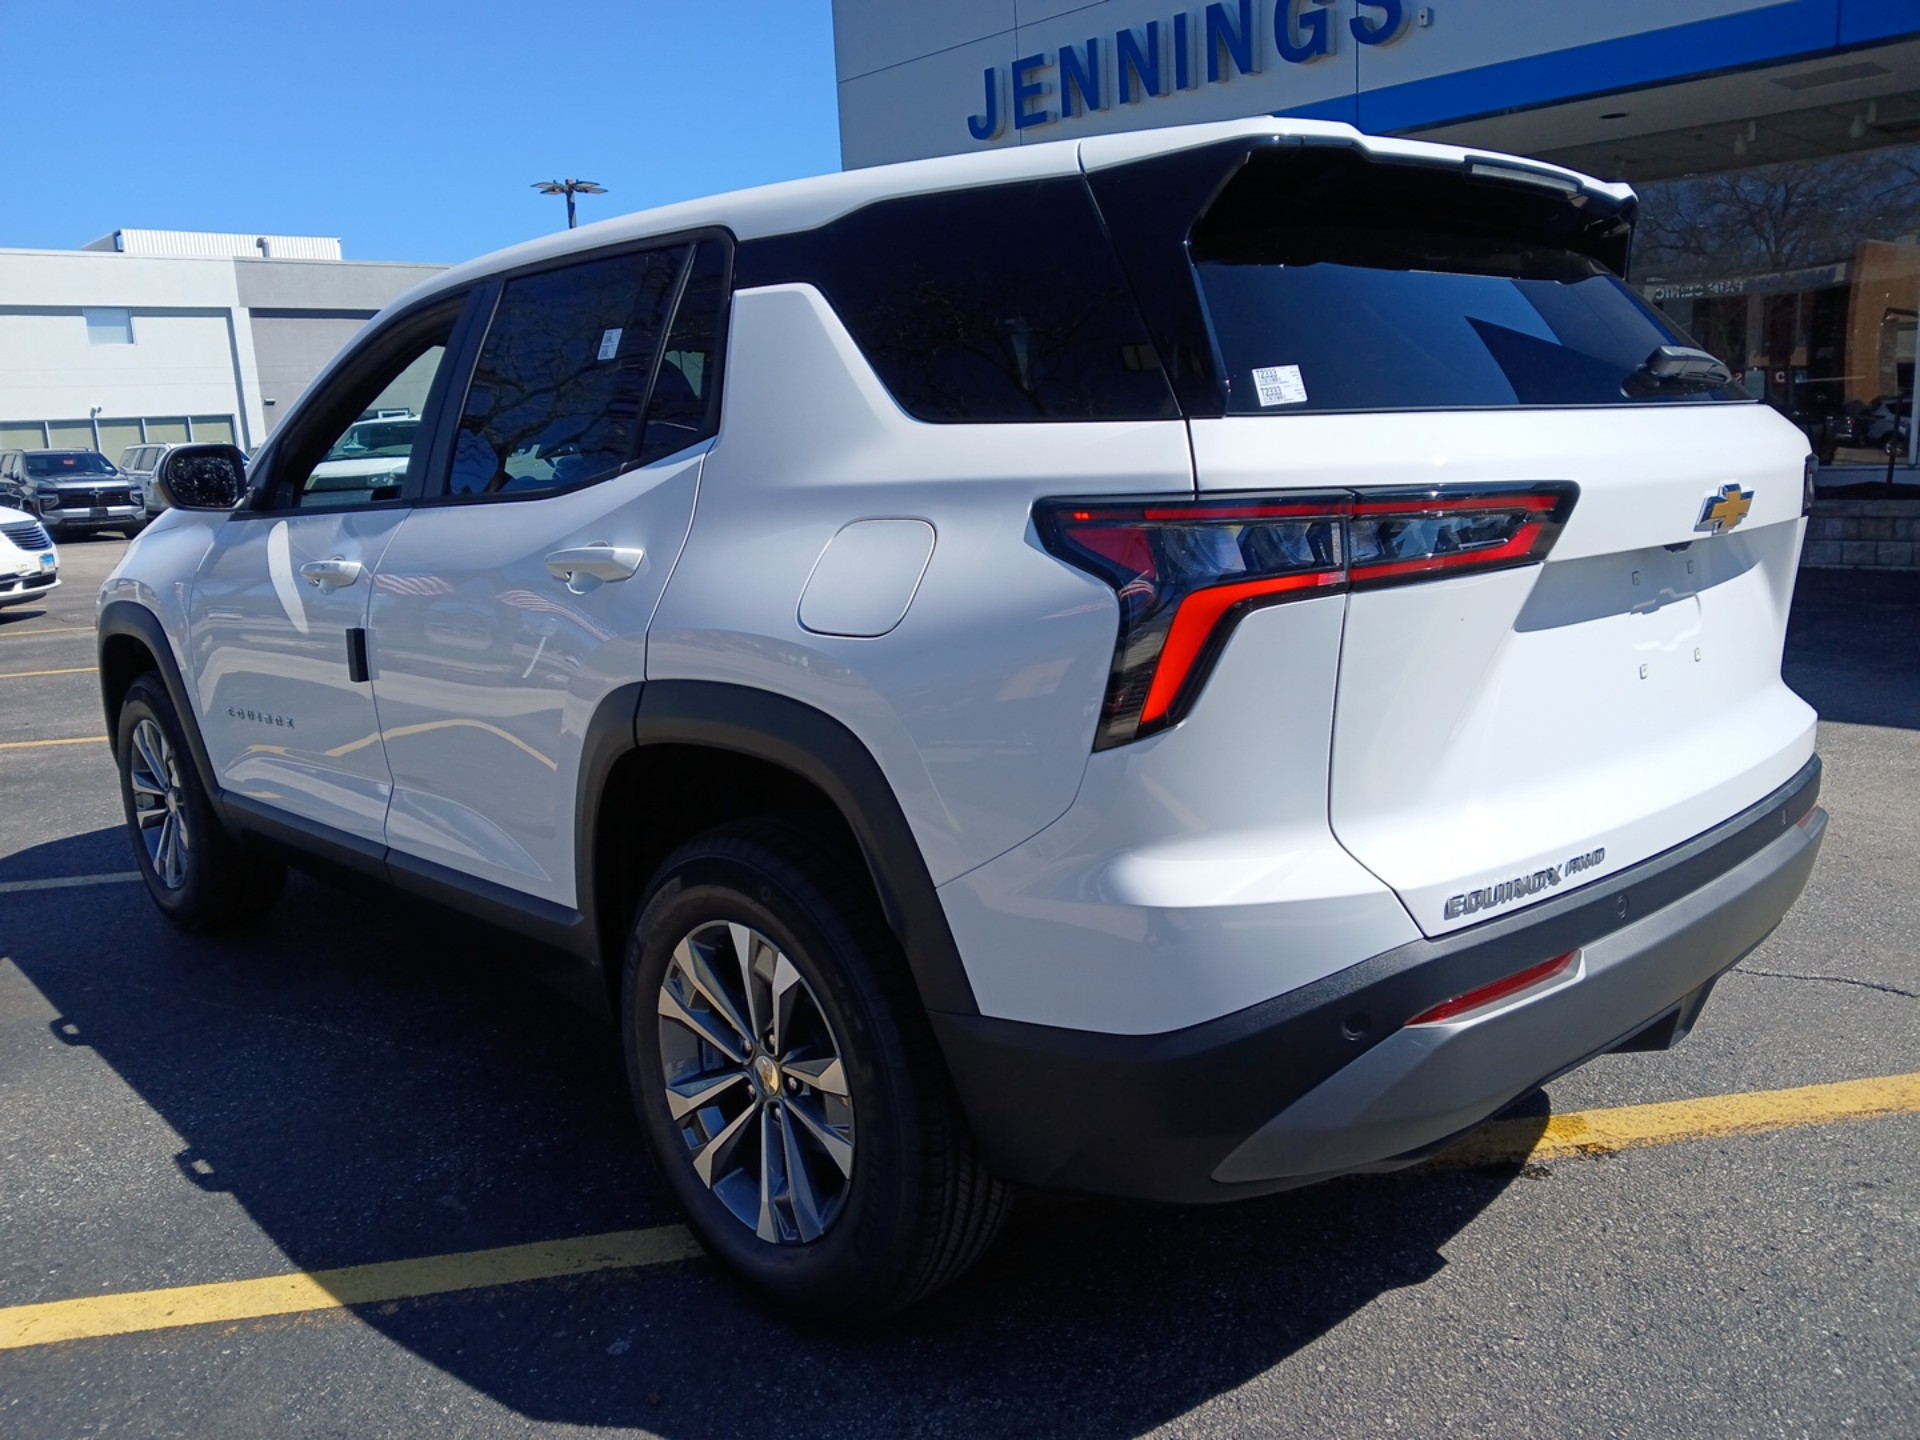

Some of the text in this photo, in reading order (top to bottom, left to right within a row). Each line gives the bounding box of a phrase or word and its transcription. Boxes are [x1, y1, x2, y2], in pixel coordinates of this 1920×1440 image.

[967, 0, 1408, 141] JENNINGS
[1443, 847, 1606, 921] EQUINOX AWD
